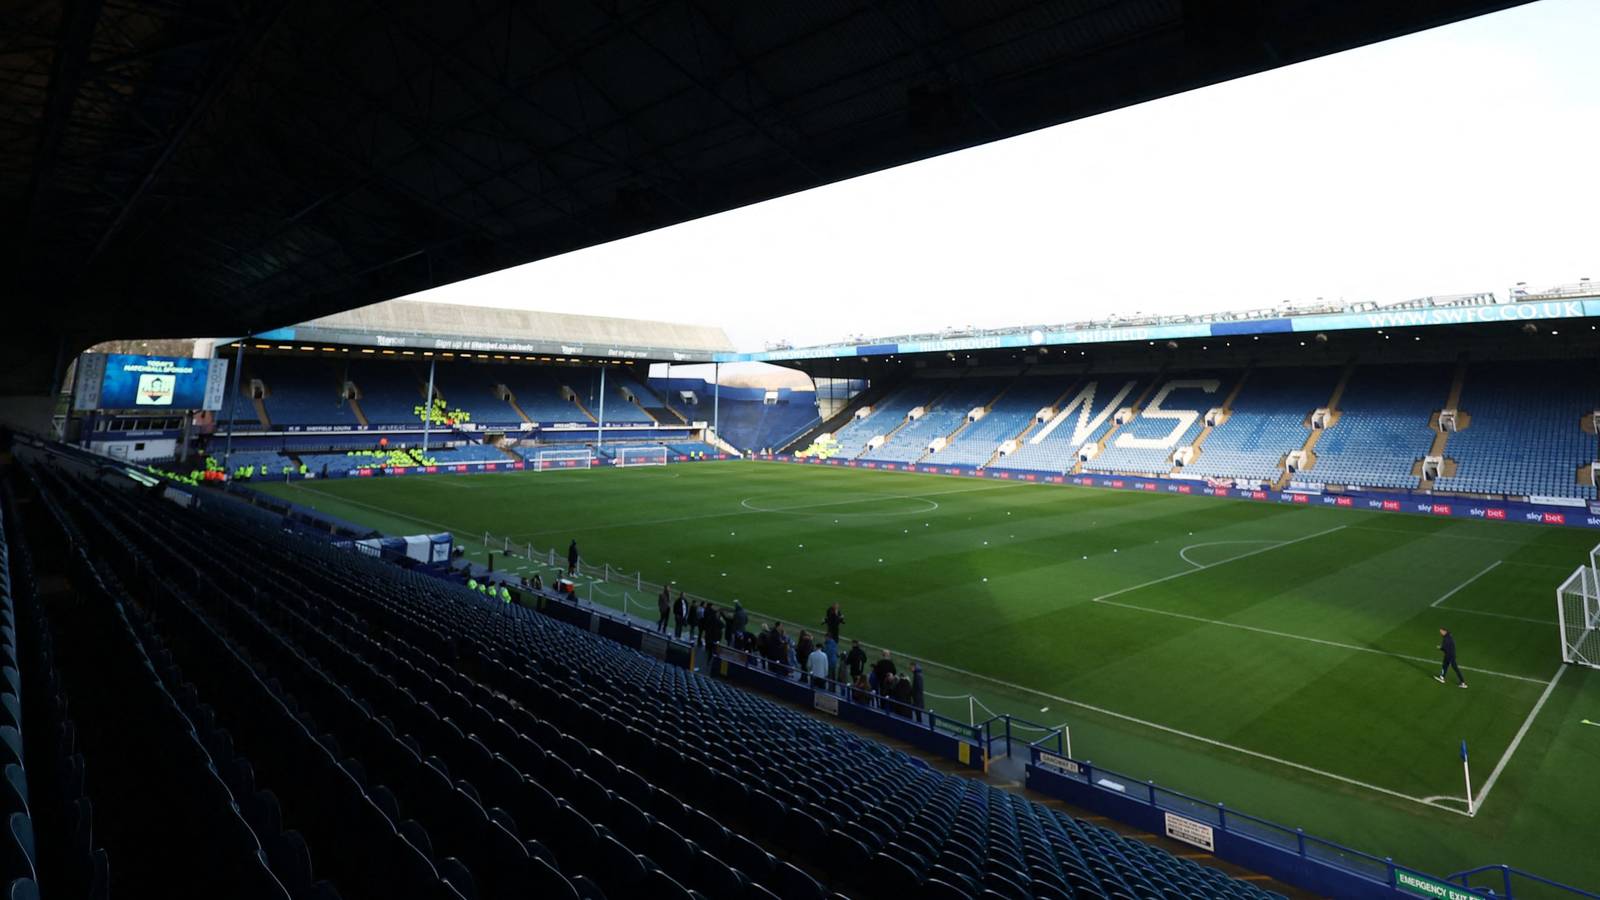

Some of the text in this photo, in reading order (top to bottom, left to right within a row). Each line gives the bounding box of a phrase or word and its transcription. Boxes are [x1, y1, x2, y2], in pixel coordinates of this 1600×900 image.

[1367, 301, 1585, 327] WWW.SWFC.CO.UK
[1168, 484, 1177, 492] sky
[1204, 487, 1226, 495] sky bet
[1241, 490, 1265, 498] sky bet
[1281, 493, 1307, 502] sky bet
[1324, 496, 1350, 505] sky bet
[1369, 500, 1398, 510] sky bet
[1418, 503, 1448, 513] sky bet
[1470, 507, 1503, 518] sky bet
[1526, 512, 1562, 521] sky bet
[1400, 874, 1446, 897] EMERGENCY
